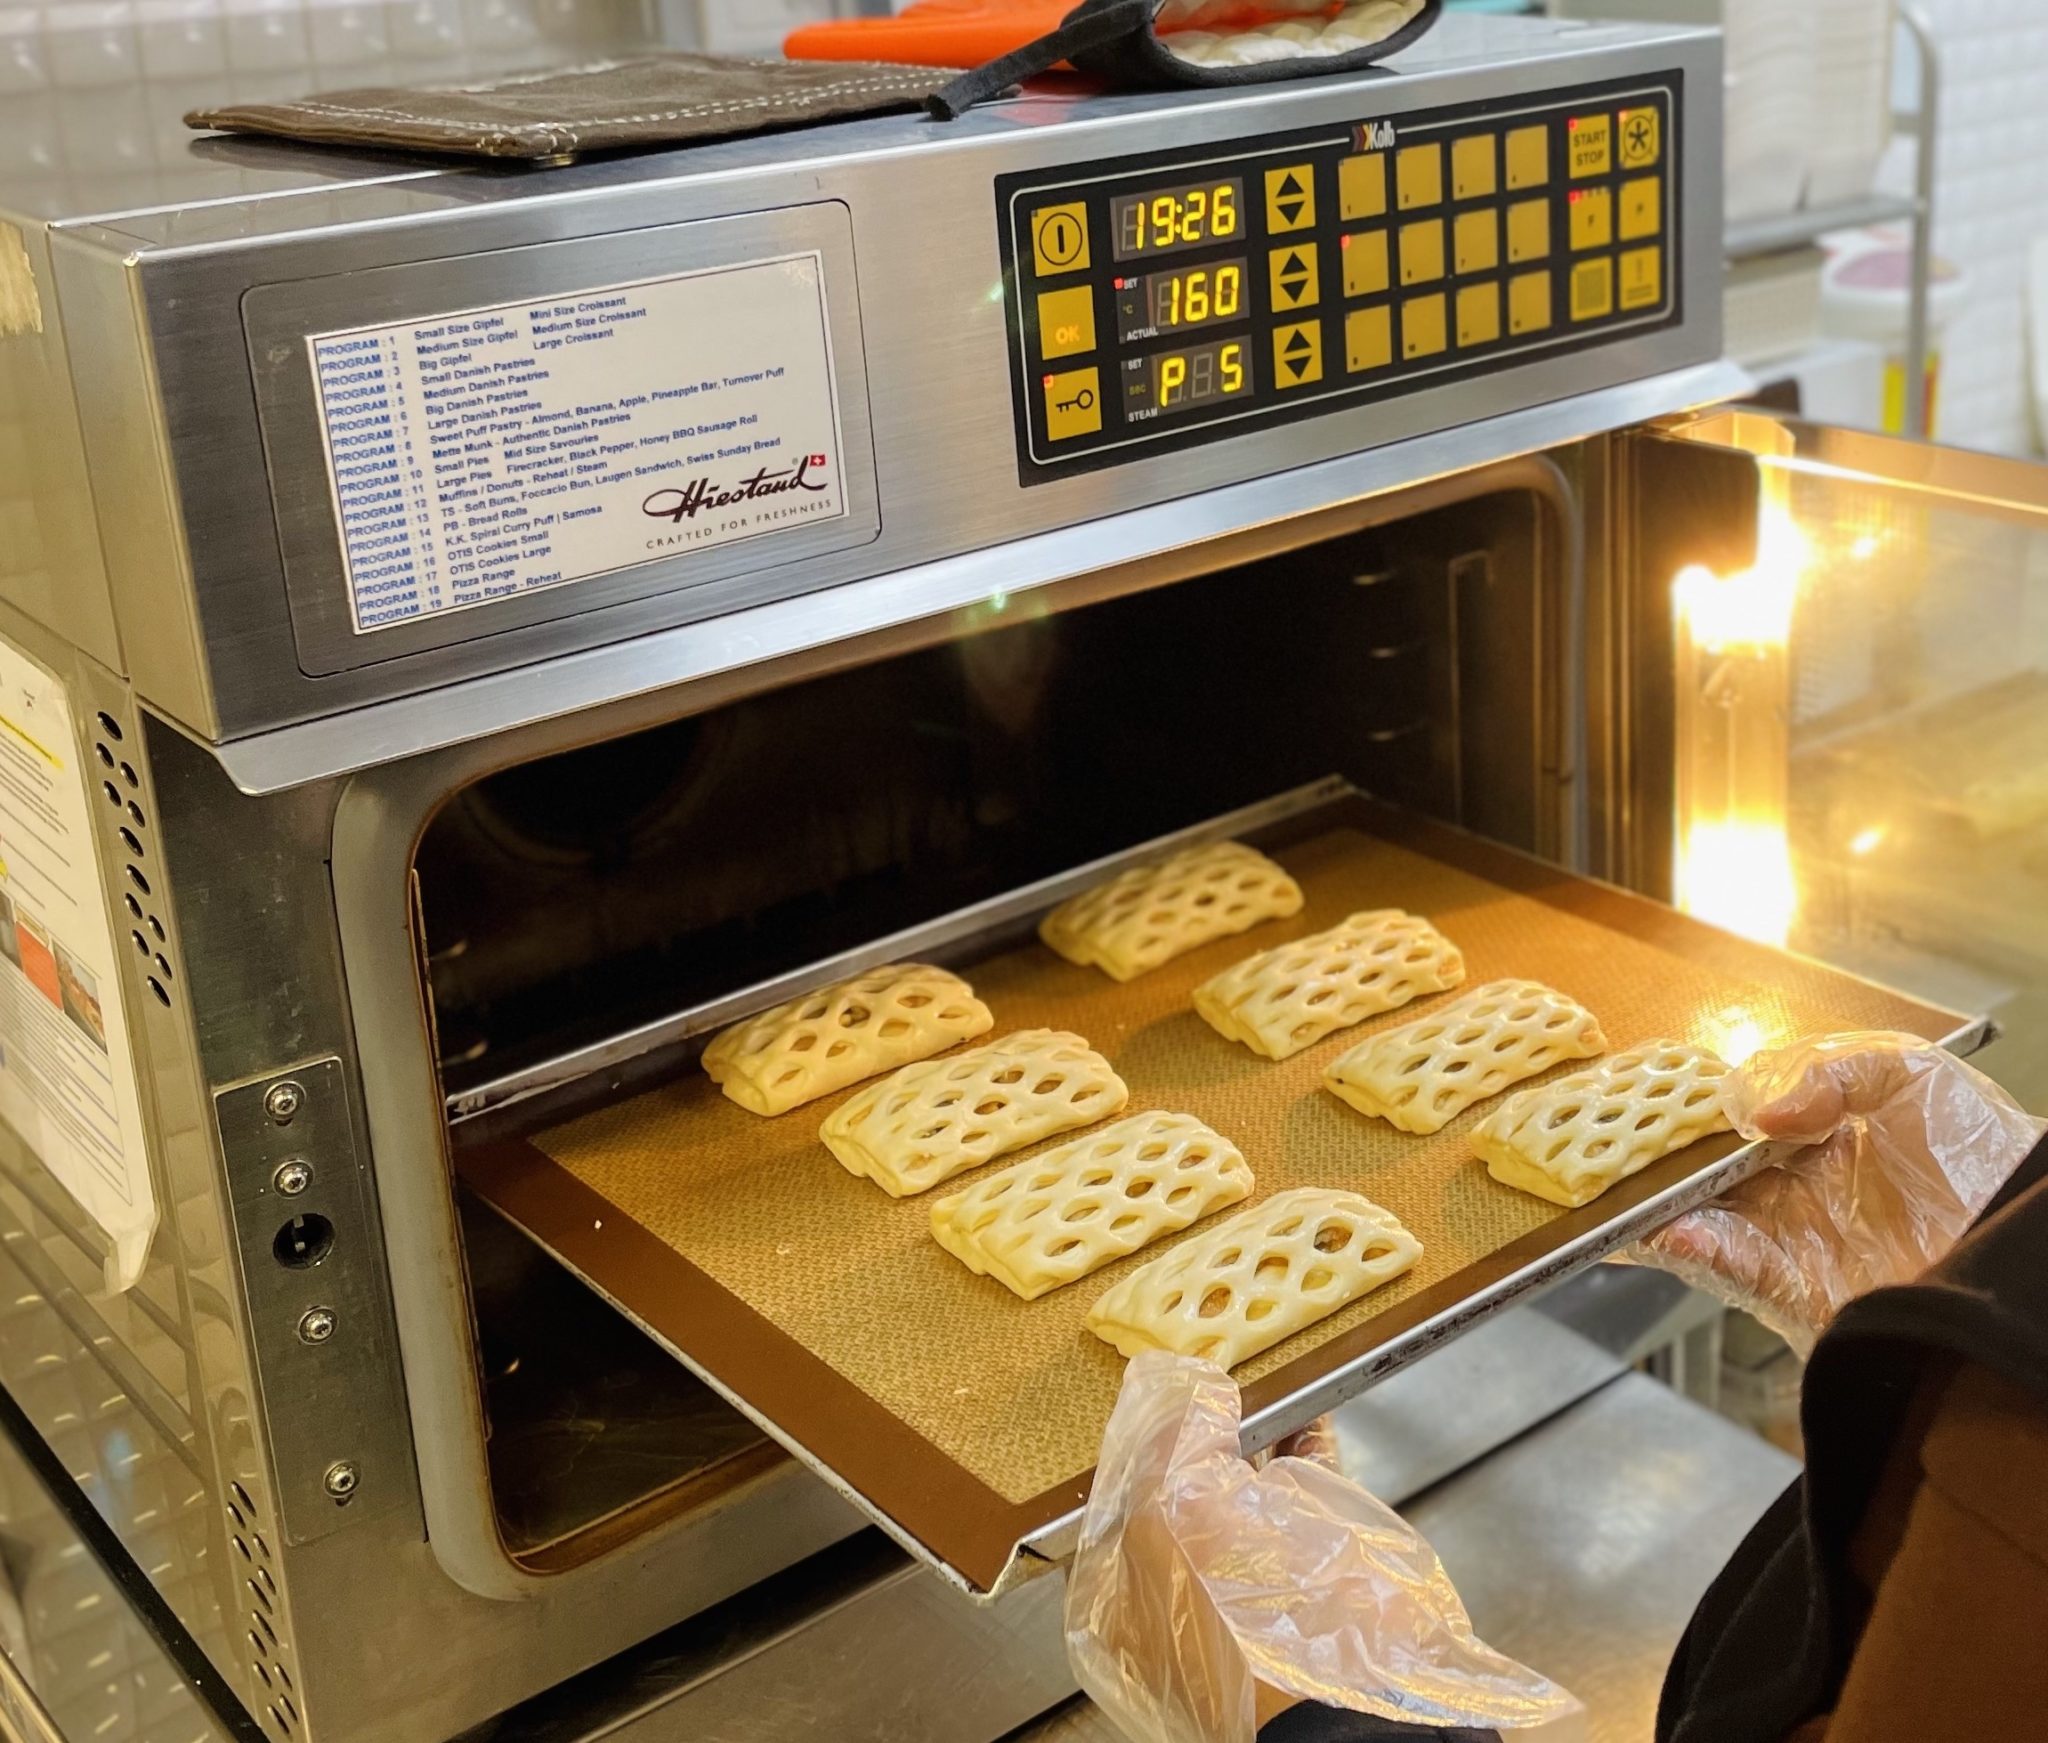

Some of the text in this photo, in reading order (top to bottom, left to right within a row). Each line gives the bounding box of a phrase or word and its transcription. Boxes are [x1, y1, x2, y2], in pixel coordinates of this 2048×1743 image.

[1370, 120, 1395, 149] Kolb
[1573, 129, 1606, 147] START
[1576, 150, 1604, 167] STOP
[1136, 185, 1236, 250] 19:26
[1123, 278, 1138, 289] SET
[1170, 266, 1239, 325] 160
[319, 297, 626, 356] PROGRAM 1 Small Size Gipfel Mini Size Croissant
[321, 308, 646, 372] PROGRAM 2 Medium Size Gipfel Medium Size Croissant
[1055, 325, 1080, 345] OK
[1126, 326, 1158, 341] ACTUAL
[324, 328, 613, 387] PROGRAM 3 Big Gipfel Large Croissant
[326, 358, 535, 402] PROGRAM 4 Small Danish Pastries
[1128, 358, 1142, 370] SET
[329, 371, 549, 417] PROGRAM 5 Medium Danish Pastries
[331, 389, 528, 433] PROGRAM 6 Big Danish Pastries
[336, 444, 394, 463] PROGRAM
[405, 441, 412, 450] 8
[430, 431, 463, 444] Sweet
[465, 425, 487, 438] Puff
[489, 421, 522, 433] Pastry
[651, 385, 698, 401] Pineapple
[766, 367, 784, 379] Puff
[1128, 407, 1158, 423] STEAM
[334, 402, 542, 448] PROGRAM 7 Large Danish Pastries
[338, 459, 396, 478] PROGRAM
[407, 456, 414, 465] 9
[464, 440, 493, 453] Munk
[503, 429, 551, 446] Authentic
[553, 421, 589, 435] Danish
[591, 414, 631, 428] Pastries
[341, 435, 599, 493] PROGRAM 10 Small Pies Mid Size Savouries
[343, 488, 400, 508] PROGRAM
[412, 484, 423, 494] 11
[437, 476, 467, 489] Large
[469, 471, 492, 482] Pies
[569, 448, 597, 461] Black
[640, 435, 670, 446] Honey
[672, 427, 695, 439] BBQ
[697, 421, 737, 434] Sausage
[739, 414, 757, 425] Roll
[346, 461, 607, 523] PROGRAM 12 Muffins Donuts Reheat Steam
[348, 518, 405, 537] PROGRAM
[417, 513, 429, 523] 13
[464, 500, 486, 512] Soft
[687, 453, 715, 465] Swiss
[717, 445, 751, 458] Sunday
[754, 437, 780, 450] Bread
[642, 455, 828, 523] Hiestand
[350, 532, 407, 552] PROGRAM
[419, 528, 431, 537] 14
[468, 512, 499, 527] Bread
[501, 507, 527, 519] Rolls
[353, 547, 409, 567] PROGRAM
[421, 542, 433, 552] 15
[470, 526, 501, 541] Spiral
[503, 522, 531, 533] Curry
[533, 514, 554, 527] Puff
[562, 506, 602, 520] Samosa
[646, 499, 832, 549] CRAFTED FOR FRESHNESS
[355, 530, 549, 582] PROGRAM 16 OTIS Cookies Small
[357, 546, 551, 596] PROGRAM 17 OTIS Cookies Large
[360, 569, 515, 611] PROGRAM 18 Pizza Range
[362, 571, 562, 624] PROGRAM 19 Pizza Range Reheat
